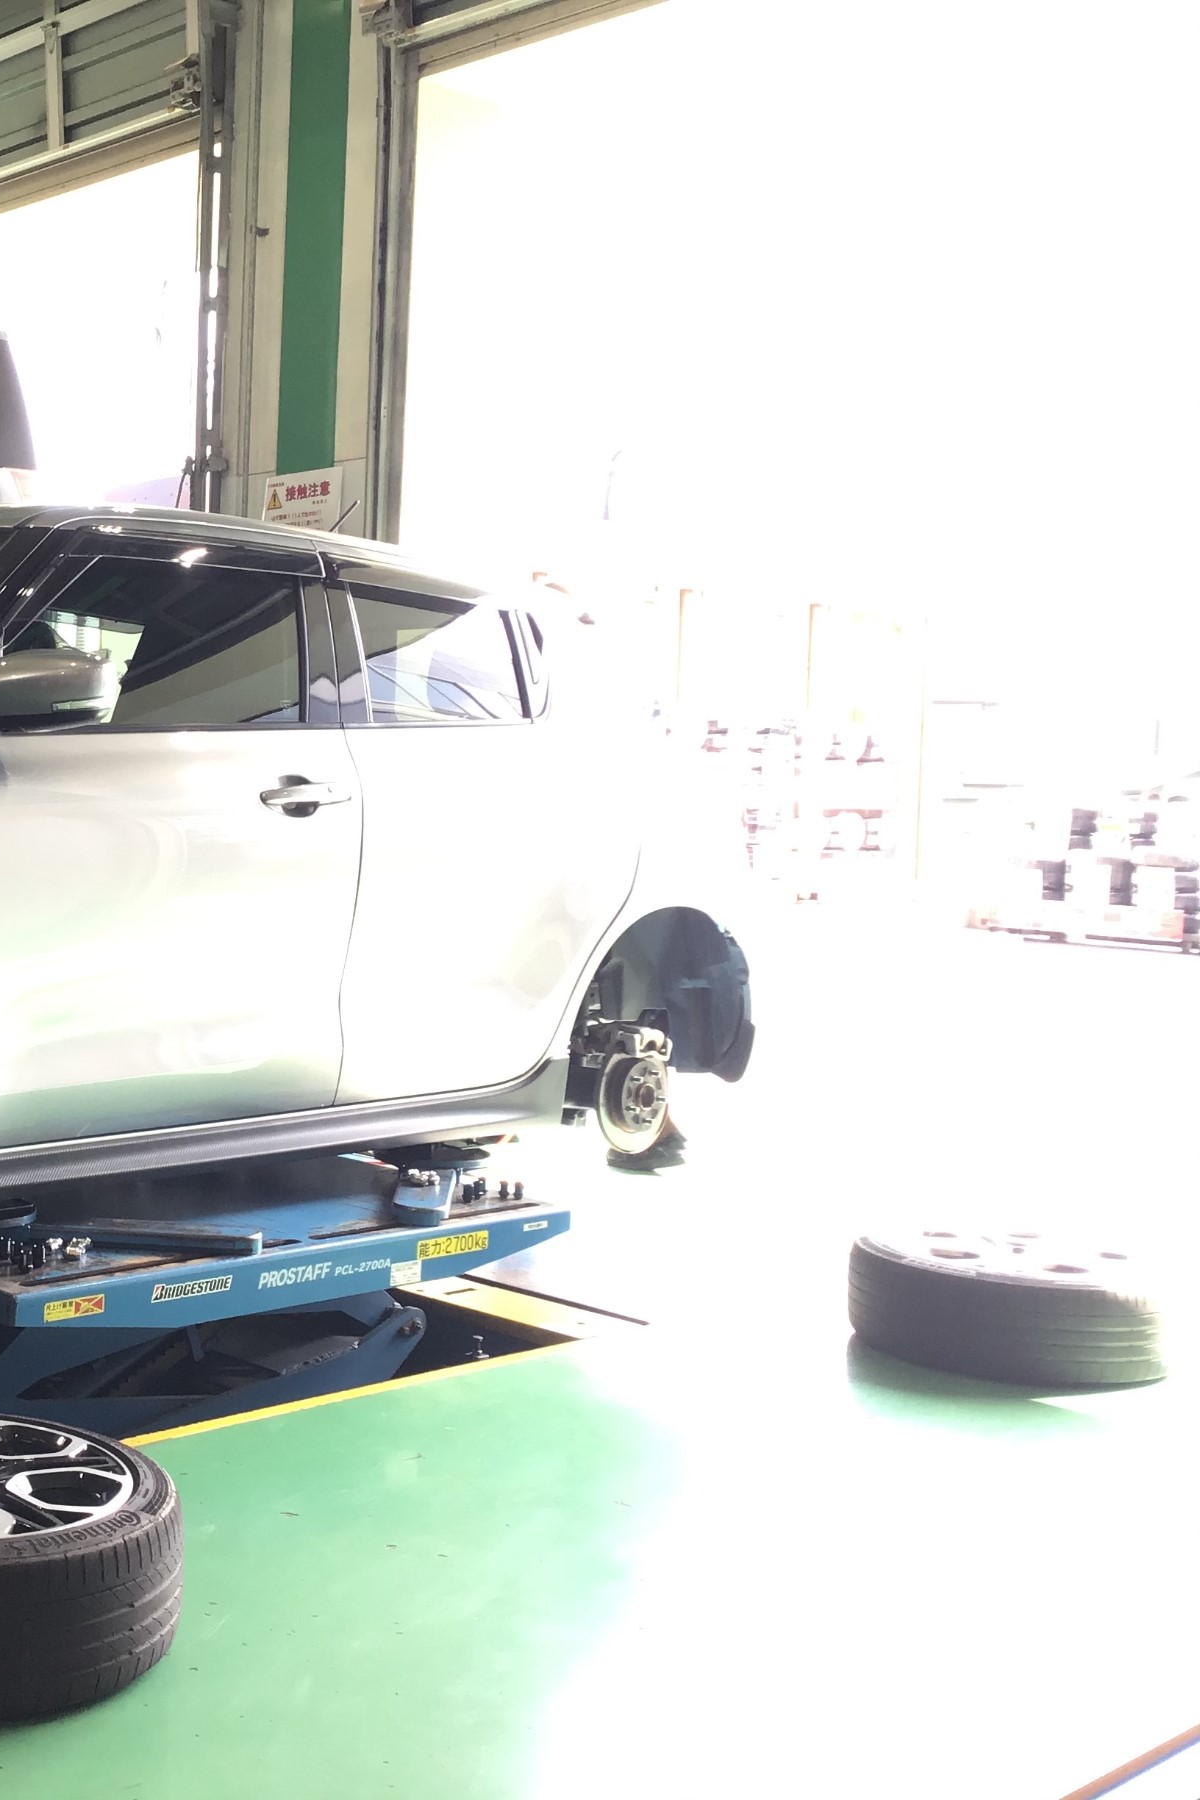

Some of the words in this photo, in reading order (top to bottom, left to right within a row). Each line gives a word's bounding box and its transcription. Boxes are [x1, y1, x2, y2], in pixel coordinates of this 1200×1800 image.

[285, 480, 331, 502] 接触注意
[257, 1261, 332, 1290] PROSTAFF
[334, 1258, 391, 1277] PCL-2700A
[152, 1276, 232, 1301] BRIDGESTONE
[26, 1509, 142, 1554] Continental
